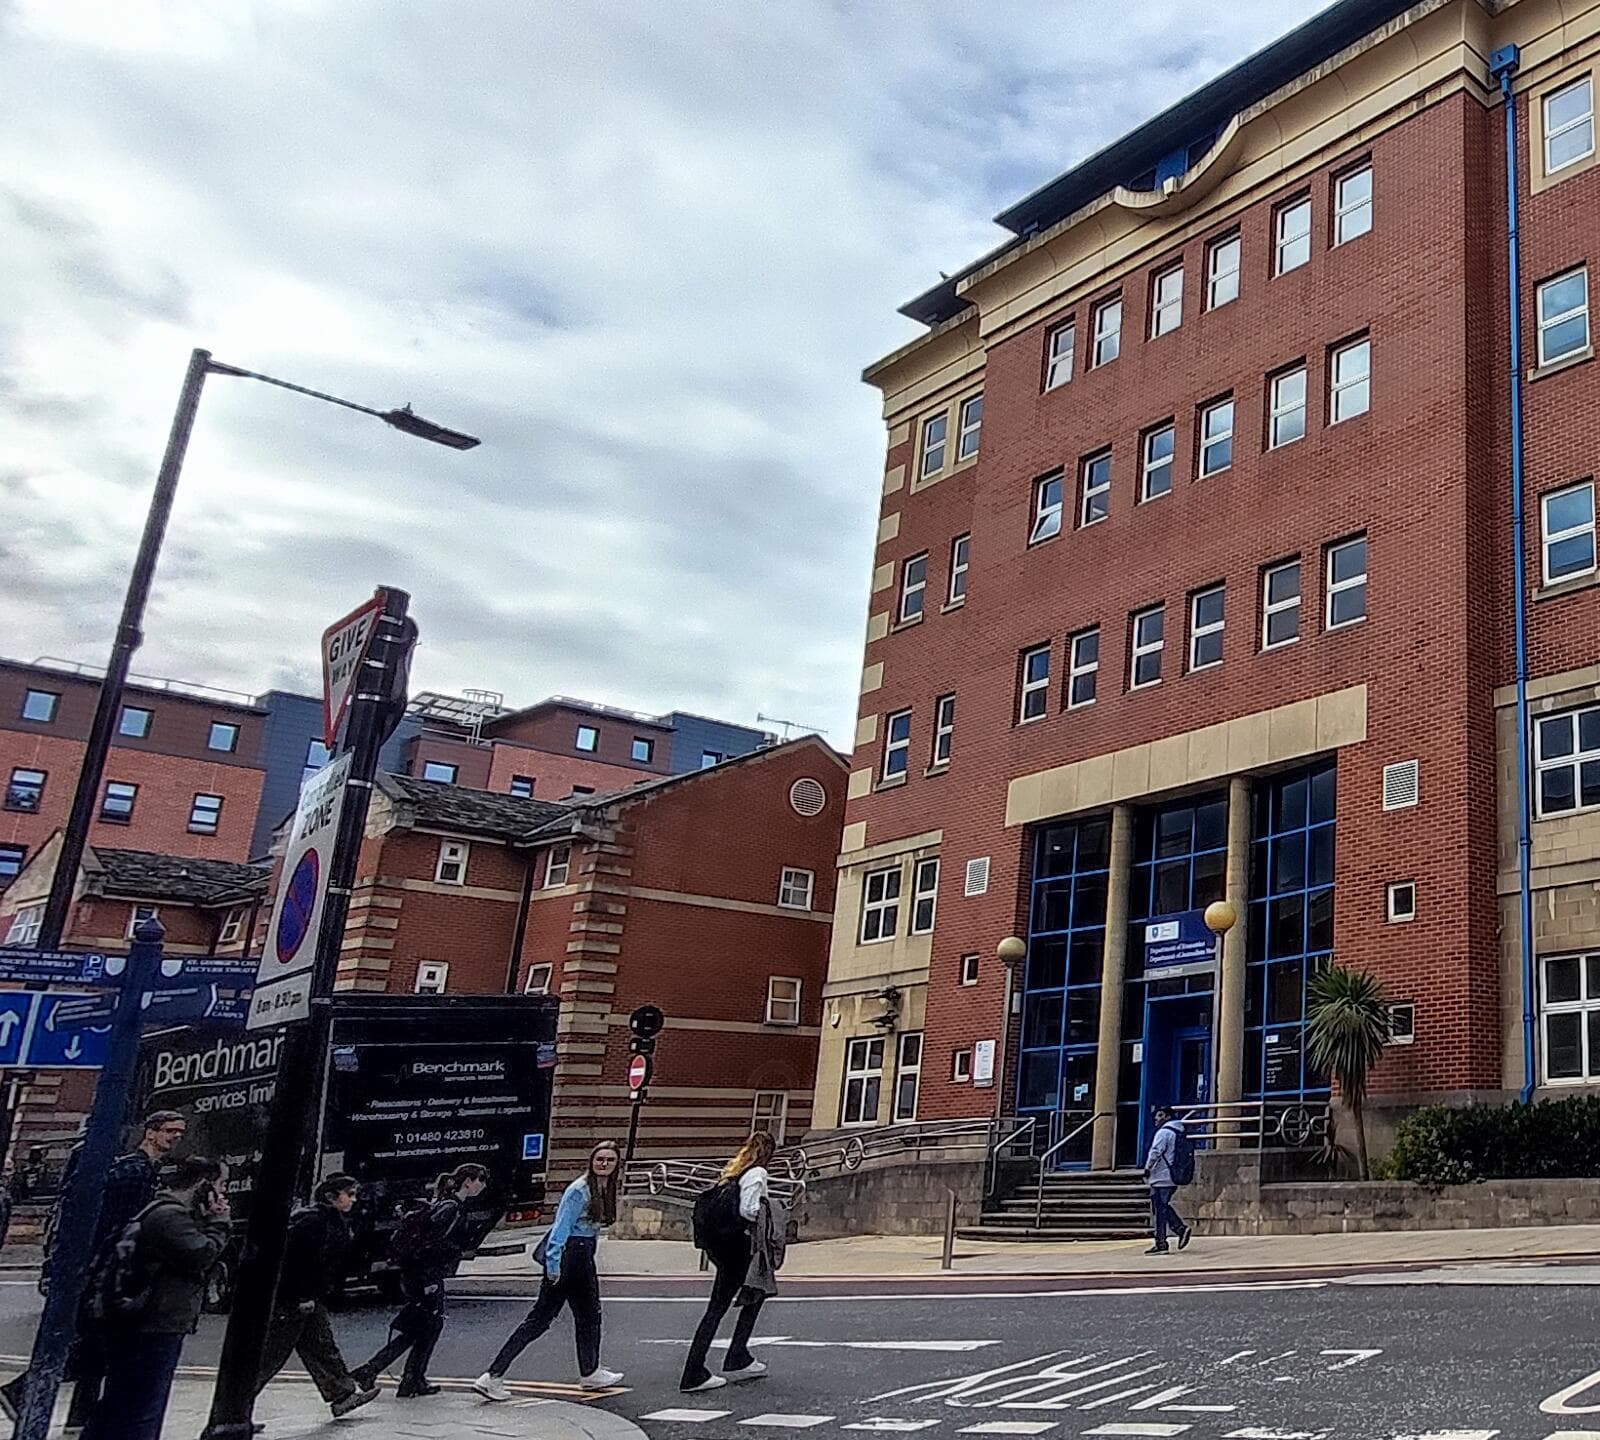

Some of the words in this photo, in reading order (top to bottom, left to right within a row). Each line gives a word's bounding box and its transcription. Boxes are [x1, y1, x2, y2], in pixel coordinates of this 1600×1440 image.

[329, 618, 367, 663] GIVE
[332, 657, 356, 686] WAY
[300, 797, 336, 840] ZONE
[89, 955, 101, 968] P
[154, 1036, 286, 1089] Benchmar
[412, 1060, 505, 1074] Benchmark
[194, 1088, 248, 1114] services
